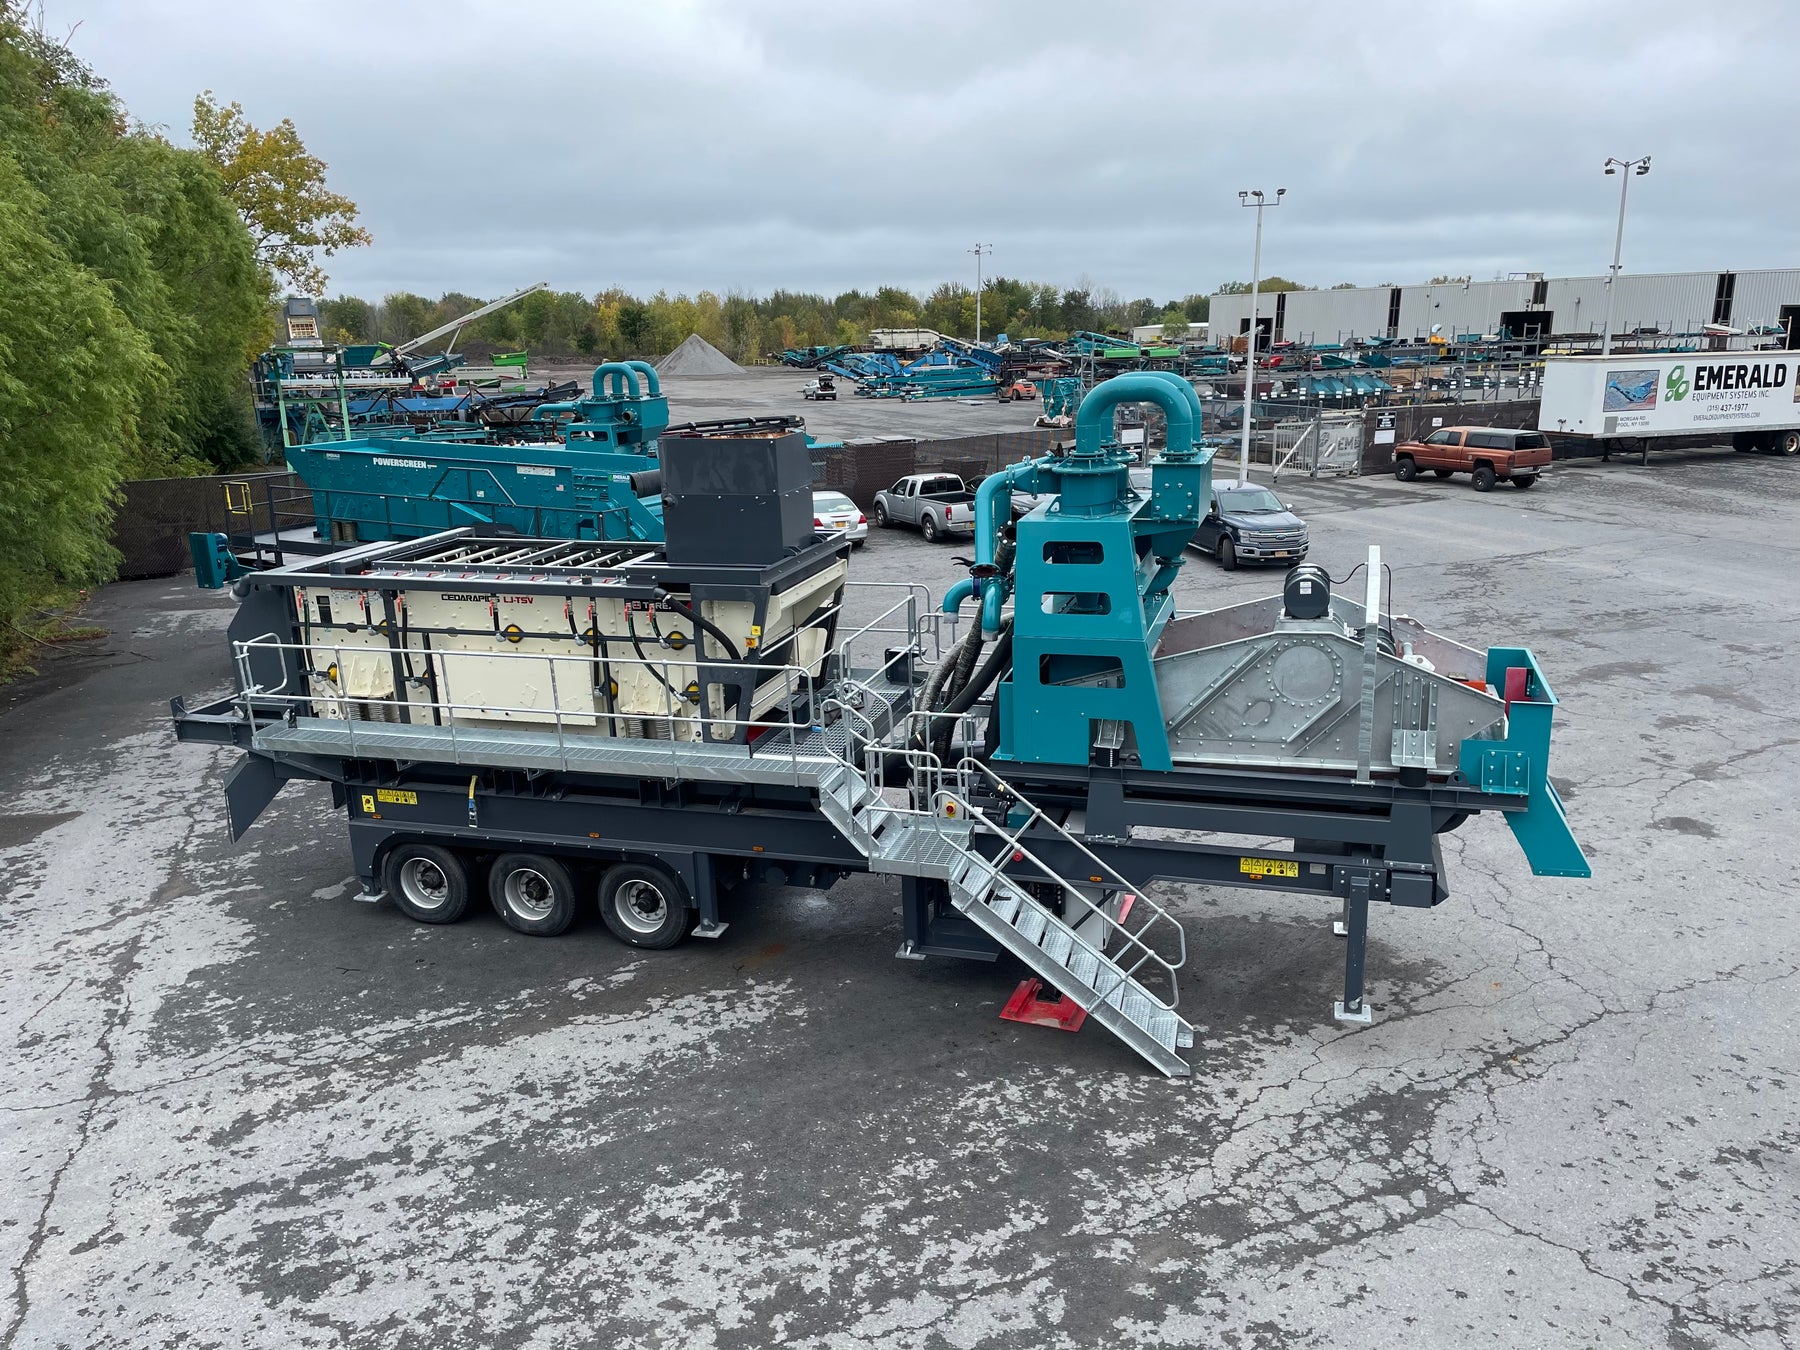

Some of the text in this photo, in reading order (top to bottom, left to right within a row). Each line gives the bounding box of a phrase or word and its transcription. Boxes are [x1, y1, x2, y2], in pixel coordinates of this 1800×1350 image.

[1694, 363, 1787, 391] EMERALD
[1692, 389, 1770, 402] EQUIPMENT SYSTEMS INC.
[1707, 403, 1749, 413] (315) 437-1977
[372, 457, 427, 469] POWERSCREEN
[643, 601, 672, 610] TRE
